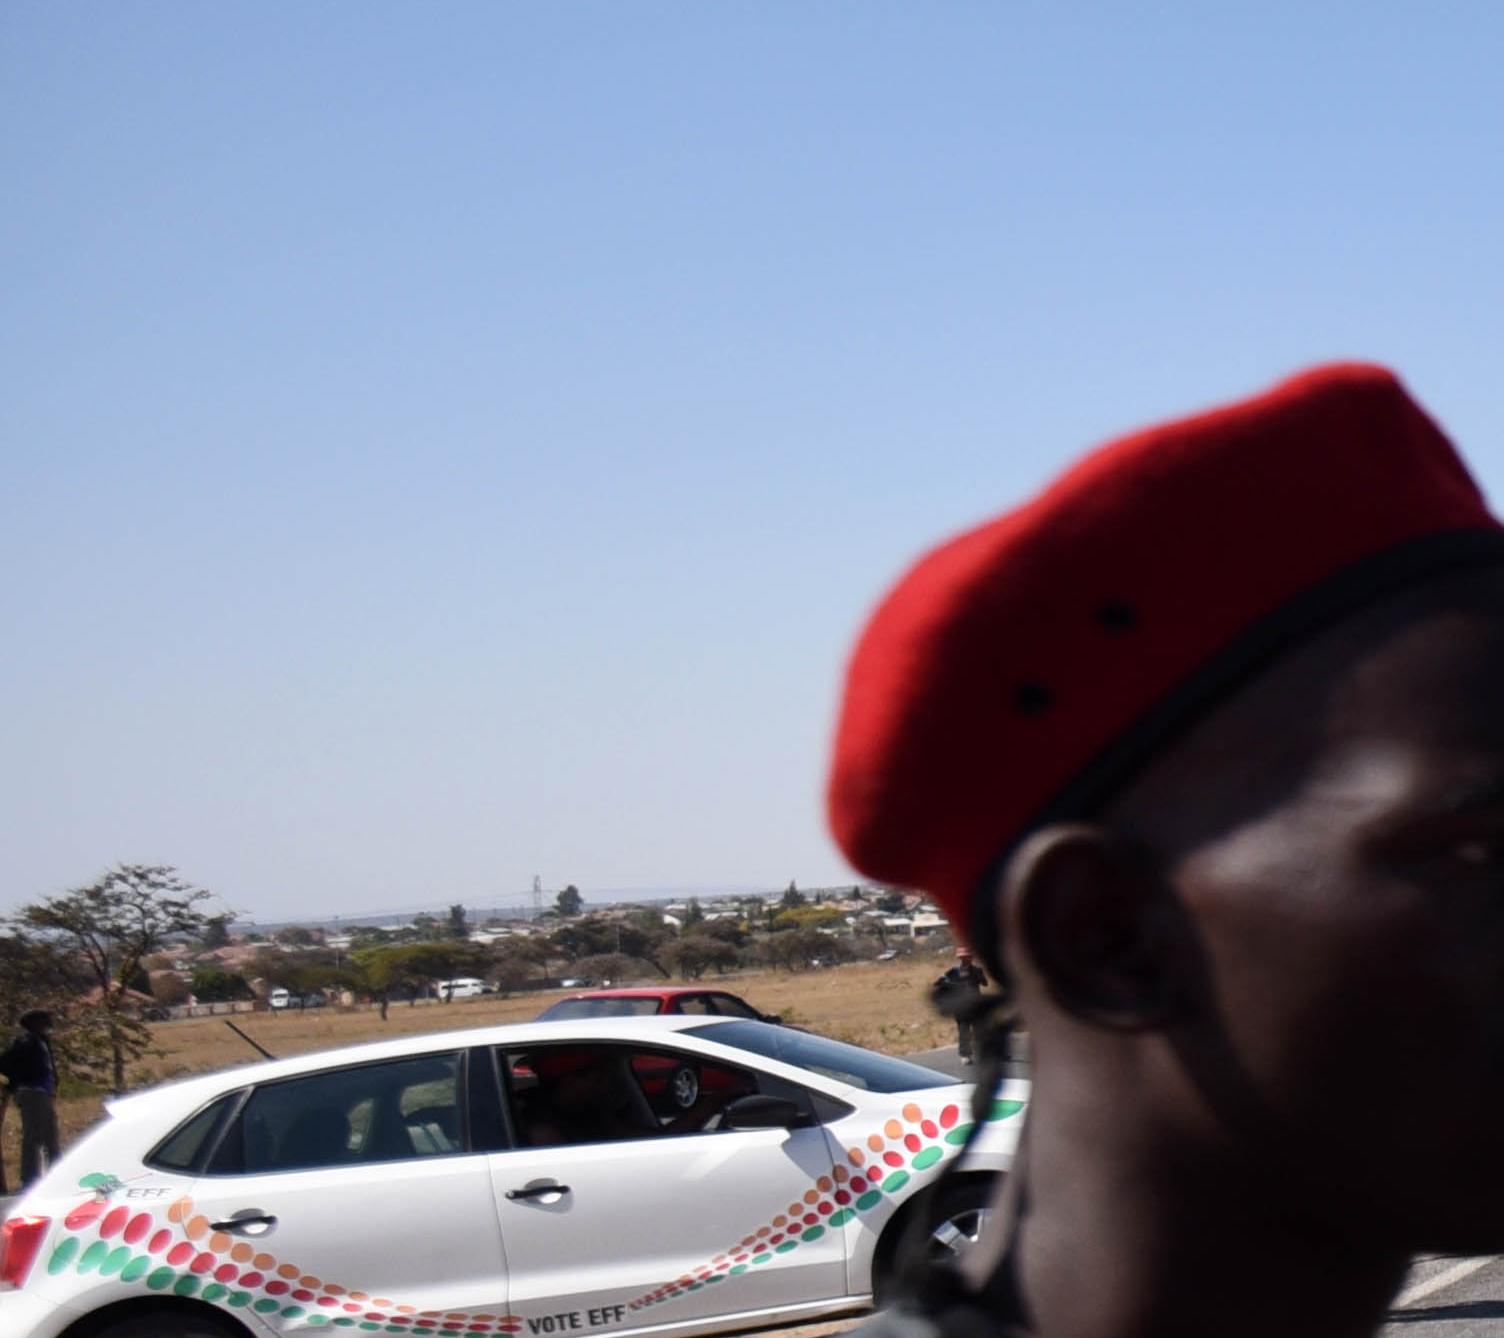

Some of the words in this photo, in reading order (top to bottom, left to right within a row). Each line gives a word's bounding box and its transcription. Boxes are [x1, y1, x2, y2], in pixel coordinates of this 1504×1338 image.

[126, 1187, 173, 1199] EFF
[527, 1311, 583, 1335] VOTE
[588, 1304, 626, 1327] EFF
